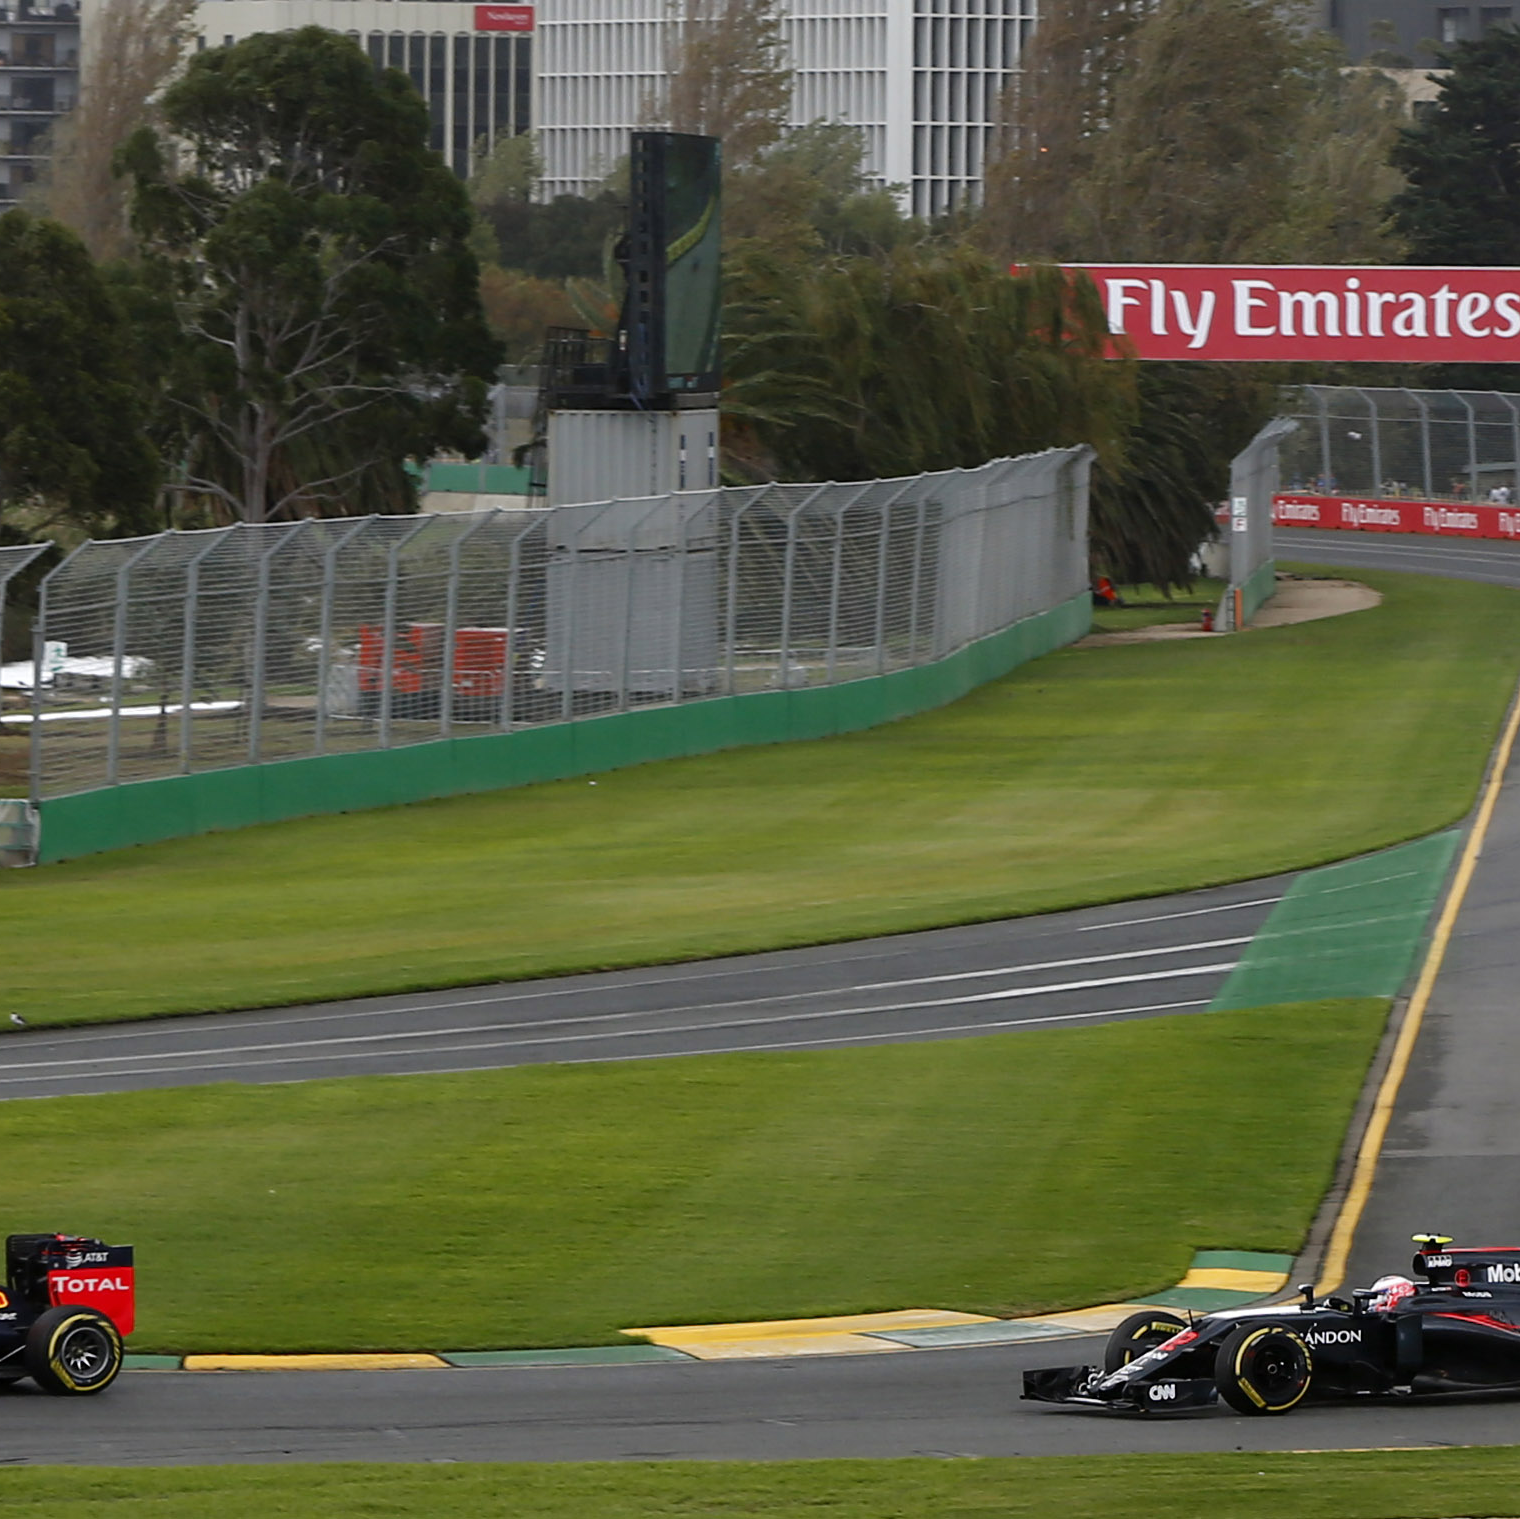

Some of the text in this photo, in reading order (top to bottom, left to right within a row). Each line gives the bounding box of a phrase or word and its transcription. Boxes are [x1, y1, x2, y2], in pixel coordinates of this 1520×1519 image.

[1104, 279, 1216, 349] Fly
[81, 1252, 109, 1262] AT&T
[51, 1276, 129, 1293] TOTAL
[1303, 1328, 1362, 1347] ANDON
[1149, 1384, 1175, 1401] CNN
